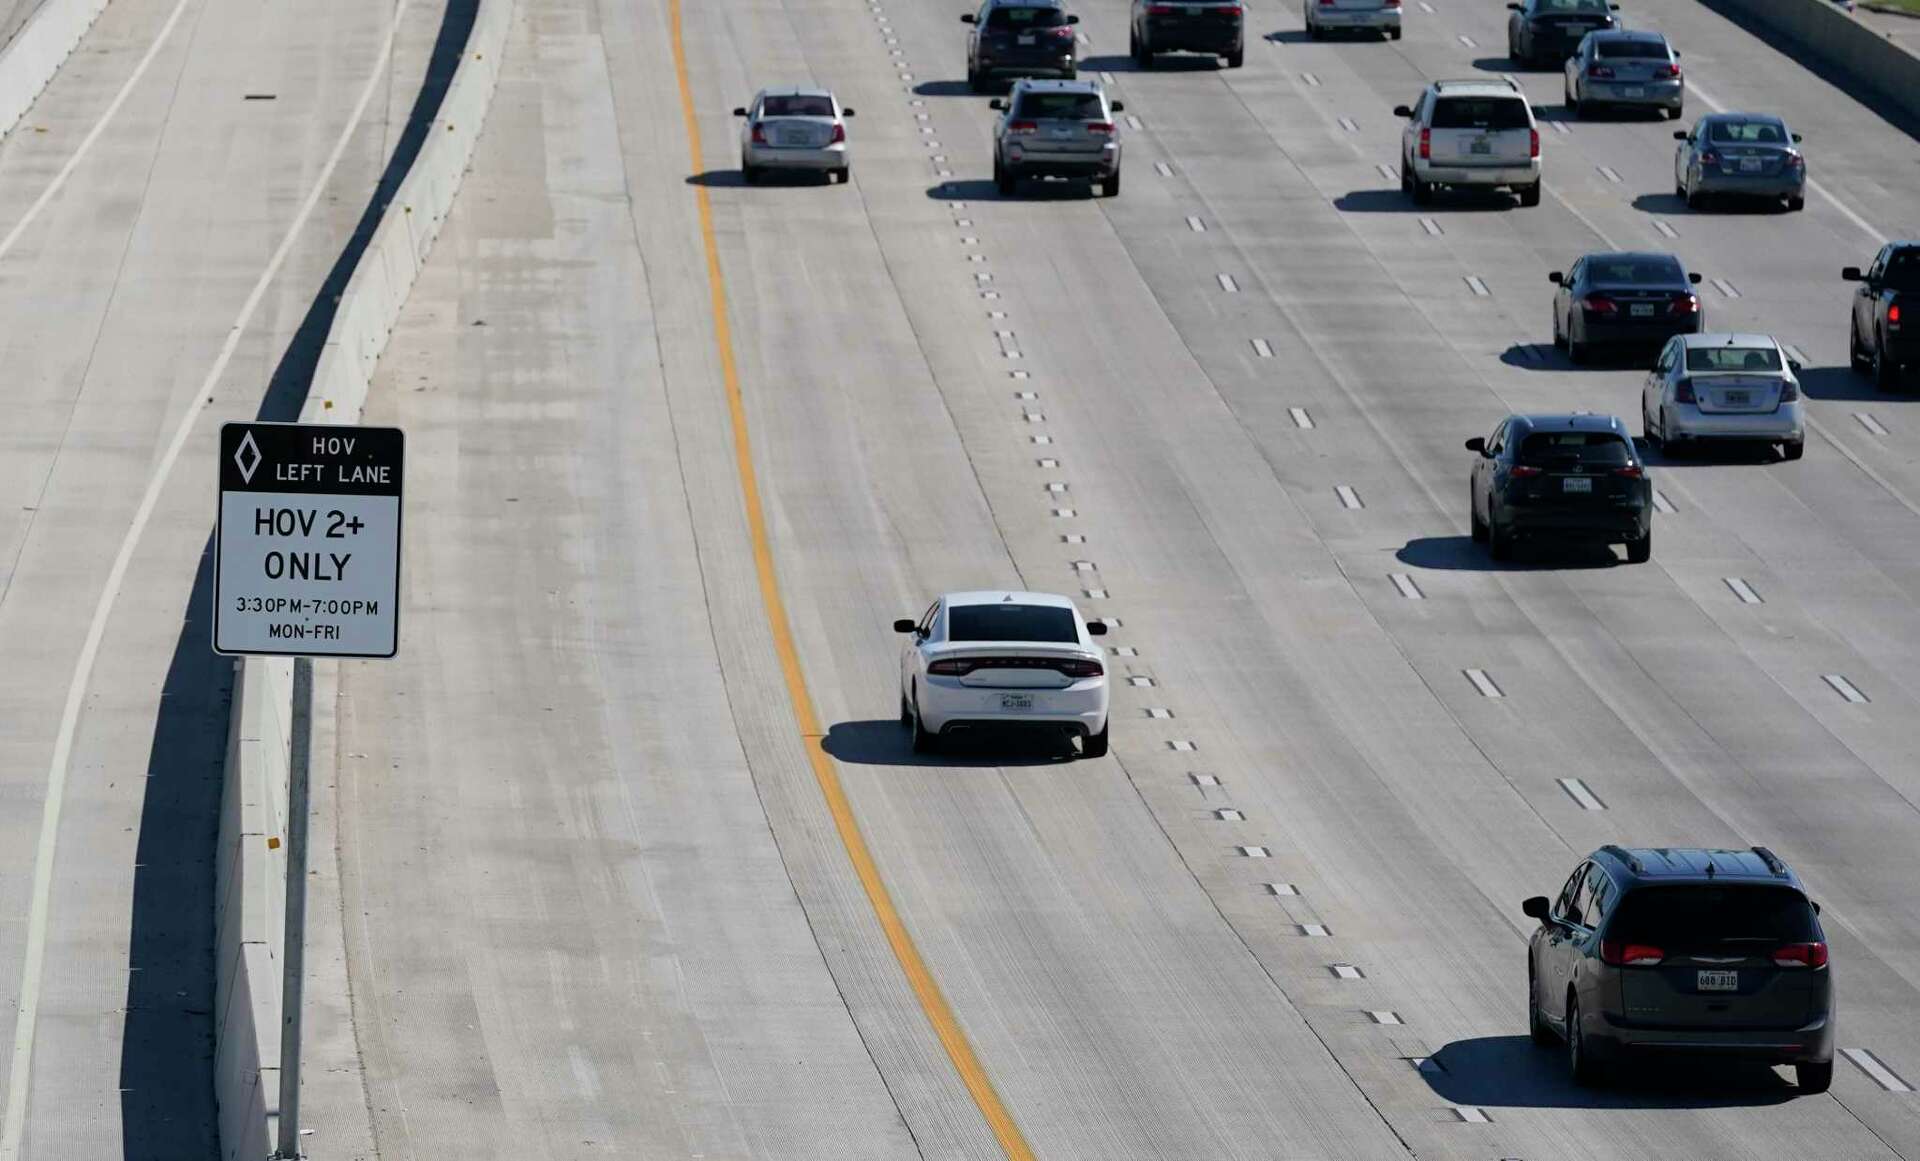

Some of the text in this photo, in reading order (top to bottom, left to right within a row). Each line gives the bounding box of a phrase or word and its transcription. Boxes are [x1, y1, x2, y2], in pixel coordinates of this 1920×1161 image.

[312, 437, 356, 455] HOV
[276, 463, 391, 484] LEFT LANE
[254, 508, 365, 538] HOV 2+
[264, 551, 352, 581] ONLY
[236, 597, 378, 616] 3:30PM-7:00PM
[269, 623, 340, 640] MON-FRI
